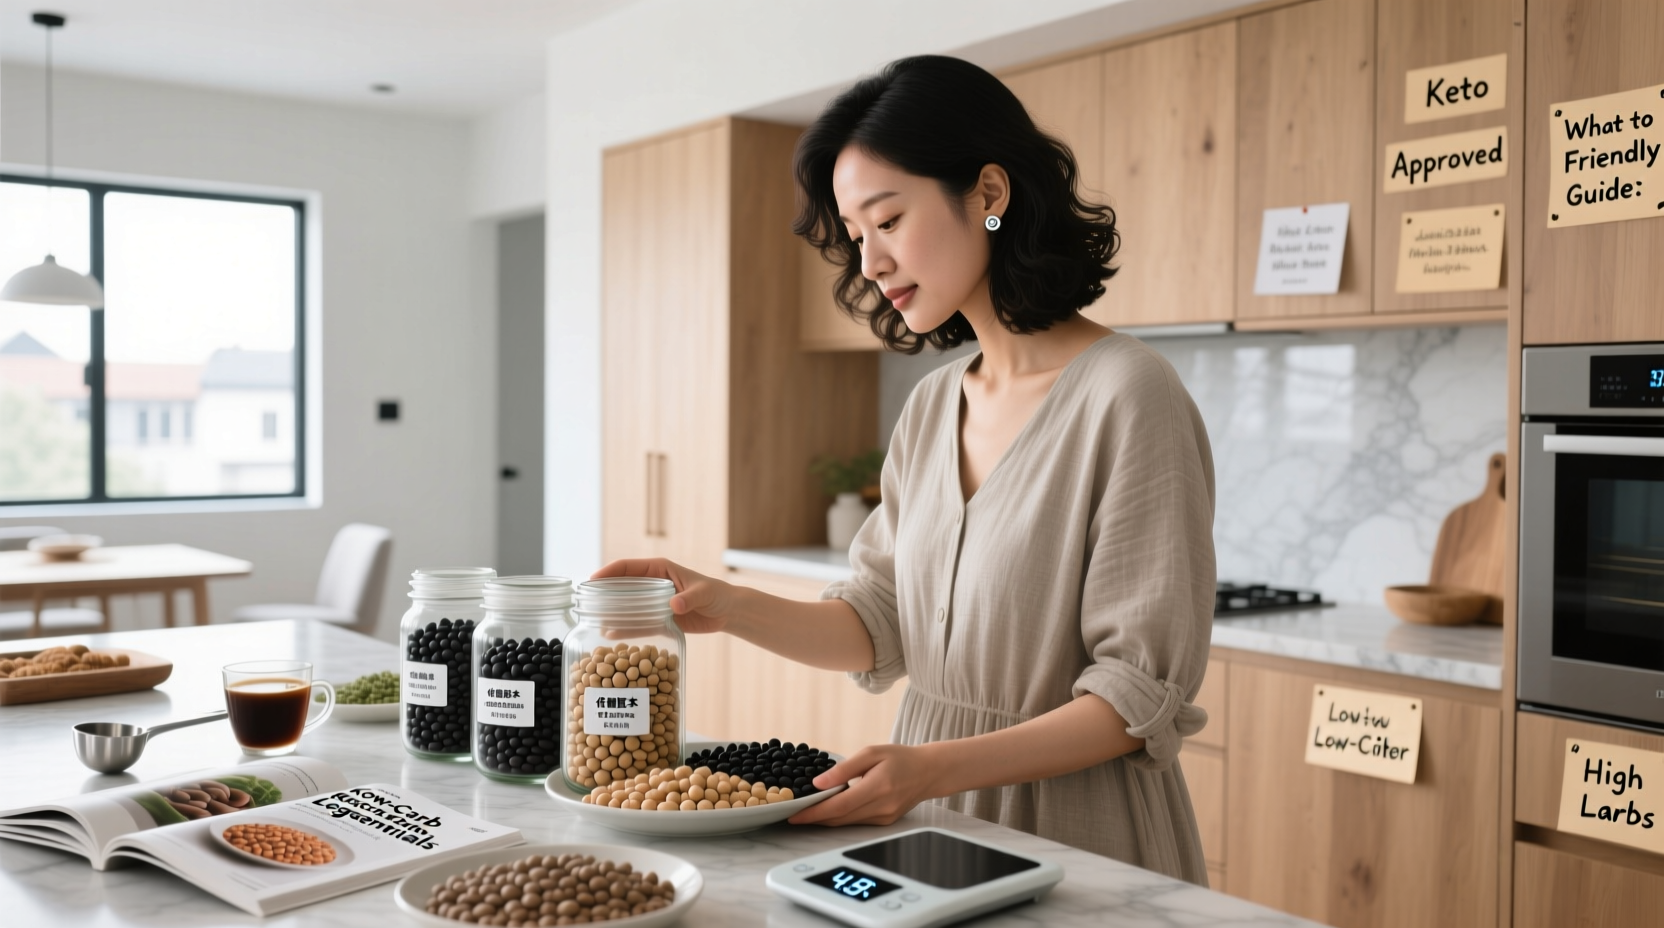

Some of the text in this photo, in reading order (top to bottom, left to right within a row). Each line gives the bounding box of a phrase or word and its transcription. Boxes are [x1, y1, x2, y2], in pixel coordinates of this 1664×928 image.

[1426, 76, 1489, 108] Keto
[1564, 110, 1654, 141] What to
[1391, 135, 1503, 184] Approved
[1564, 138, 1662, 173] Friendly
[1566, 176, 1643, 207] Guide:
[1583, 757, 1643, 796] High
[1580, 793, 1655, 829] Larbs
